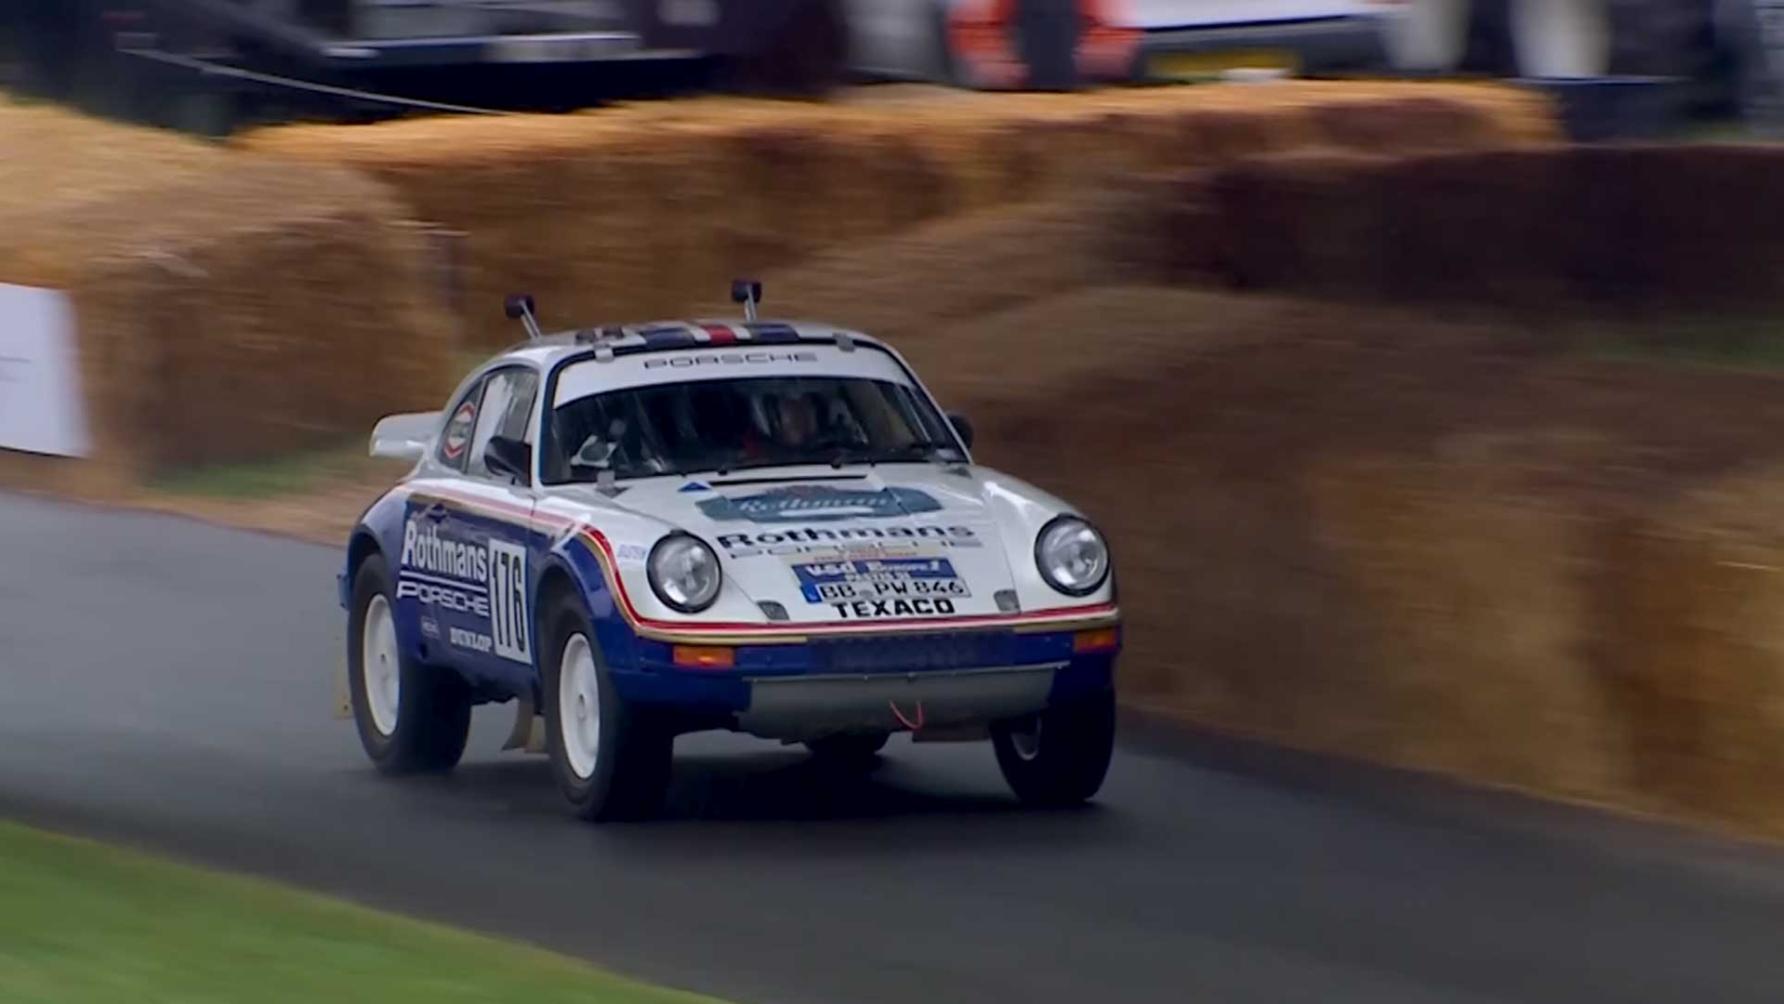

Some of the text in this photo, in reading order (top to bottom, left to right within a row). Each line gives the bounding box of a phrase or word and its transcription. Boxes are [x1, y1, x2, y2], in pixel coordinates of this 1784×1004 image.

[644, 353, 817, 369] PORSCHE
[716, 525, 975, 549] Rothmans
[400, 519, 488, 583] Rothmans
[396, 580, 490, 618] PORSCHE
[493, 549, 526, 653] 176
[819, 580, 964, 600] BB PW 846
[831, 599, 955, 618] TEXACO
[449, 626, 492, 653] DUNLOP
